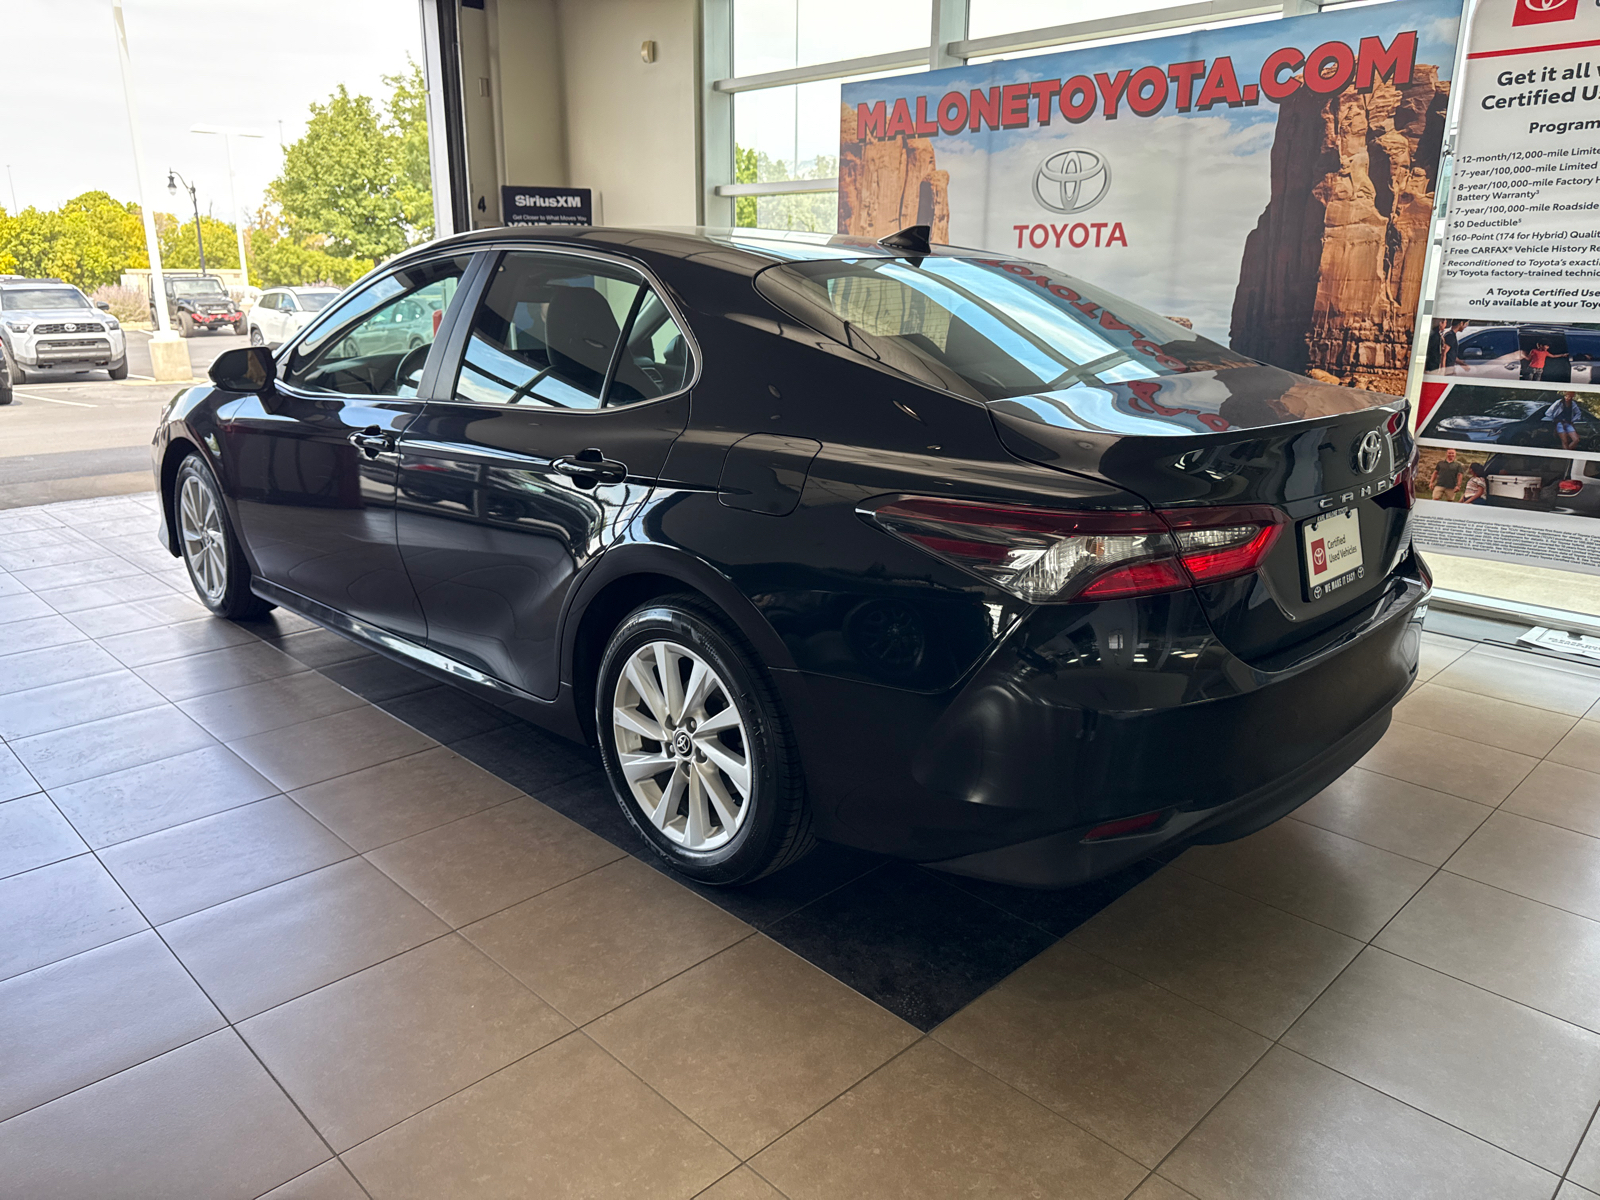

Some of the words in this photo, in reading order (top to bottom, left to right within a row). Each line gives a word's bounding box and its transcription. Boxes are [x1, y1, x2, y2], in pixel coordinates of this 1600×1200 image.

[1497, 70, 1536, 86] Get
[1541, 66, 1557, 82] it
[1562, 62, 1590, 80] all
[856, 31, 1418, 143] MALONETOYOTA.COM
[1482, 86, 1576, 110] Certified
[1582, 85, 1600, 101] U
[1462, 148, 1569, 164] 12-month/12,000-mile
[1460, 164, 1557, 178] 7-year/100,000-mile
[1560, 161, 1598, 171] Limited
[1458, 178, 1553, 192] 8-year/100,000-mile
[1556, 177, 1594, 186] Factory
[478, 196, 486, 213] 4
[514, 194, 582, 208] SiriusXM
[1456, 193, 1490, 202] Battery
[1455, 204, 1550, 216] 7-year/100,000-mile
[1552, 202, 1600, 211] Roadside
[1453, 220, 1464, 228] $0
[1014, 222, 1128, 250] TOYOTA
[1451, 233, 1494, 242] 160-Point
[1496, 232, 1514, 241] (174
[1517, 232, 1530, 240] for
[1532, 231, 1568, 242] Hybrid)
[1450, 247, 1470, 255] Free
[1515, 245, 1549, 253] Vehicle
[1551, 245, 1588, 254] History
[1447, 259, 1514, 267] Reconditioned
[1446, 270, 1458, 278] by
[1460, 270, 1489, 278] Toyota
[1491, 270, 1563, 278] factory-trained
[1486, 288, 1494, 296] A
[1496, 288, 1530, 298] Toyota
[1532, 288, 1579, 297] Certified
[1468, 298, 1491, 308] only
[1492, 299, 1539, 307] available
[1540, 300, 1552, 308] at
[1553, 301, 1578, 309] your
[1327, 534, 1346, 550] Certified
[1329, 550, 1340, 563] Used
[1340, 544, 1357, 558] Vehicles
